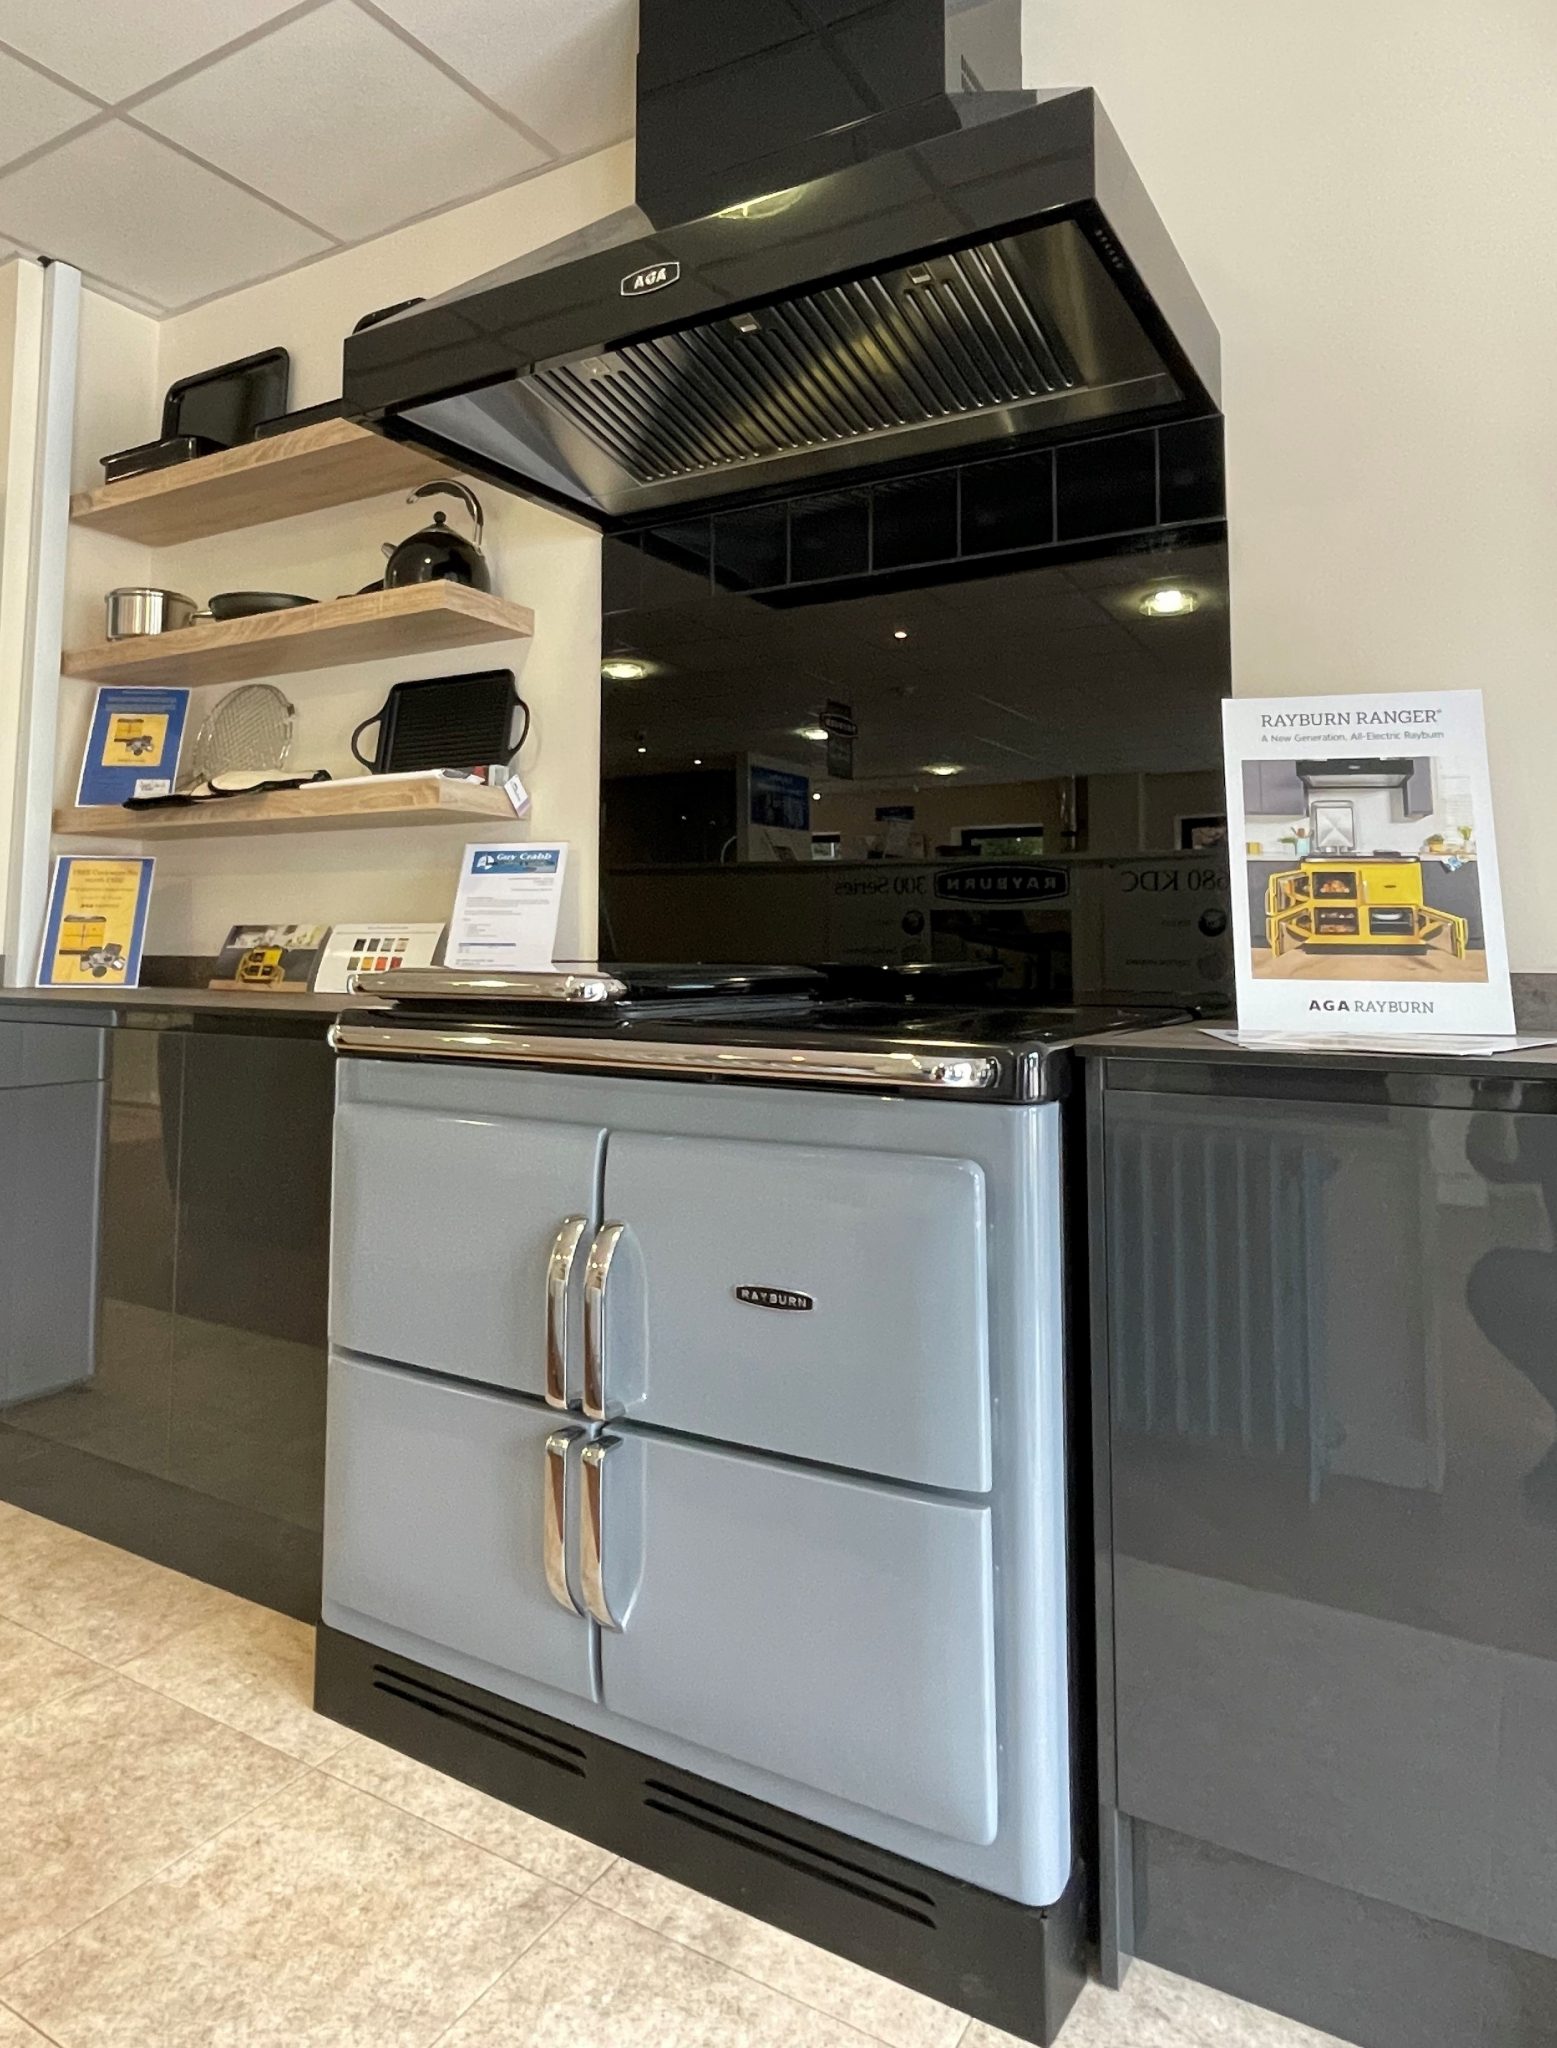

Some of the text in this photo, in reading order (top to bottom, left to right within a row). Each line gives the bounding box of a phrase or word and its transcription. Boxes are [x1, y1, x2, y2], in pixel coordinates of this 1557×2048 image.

[634, 268, 666, 289] AGA
[1261, 712, 1351, 727] RAYBURN
[1261, 734, 1268, 742] A
[1271, 734, 1292, 742] New
[1404, 730, 1445, 740] Rayburn
[519, 852, 553, 860] Crabb
[1309, 1000, 1434, 1014] AGA RAYBURN
[741, 1289, 807, 1308] RAYBURN
